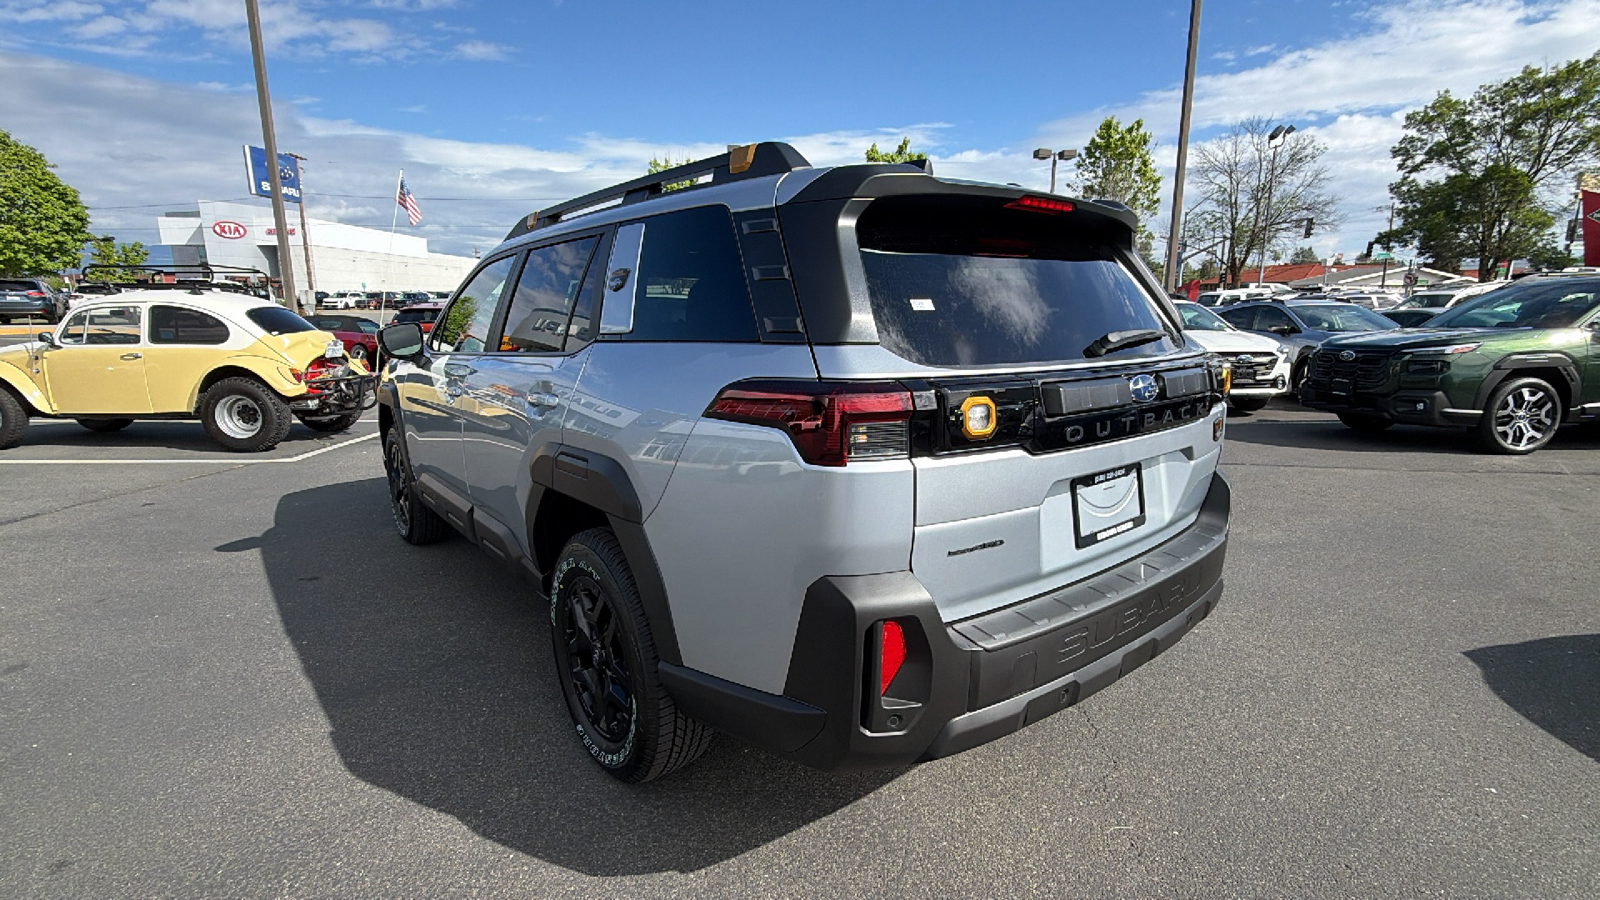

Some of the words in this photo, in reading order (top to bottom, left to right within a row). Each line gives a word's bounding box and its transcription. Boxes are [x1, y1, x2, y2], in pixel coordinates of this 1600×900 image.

[261, 181, 299, 197] SARU
[1065, 402, 1207, 442] OUTBACK
[1056, 576, 1201, 664] SUBARU
